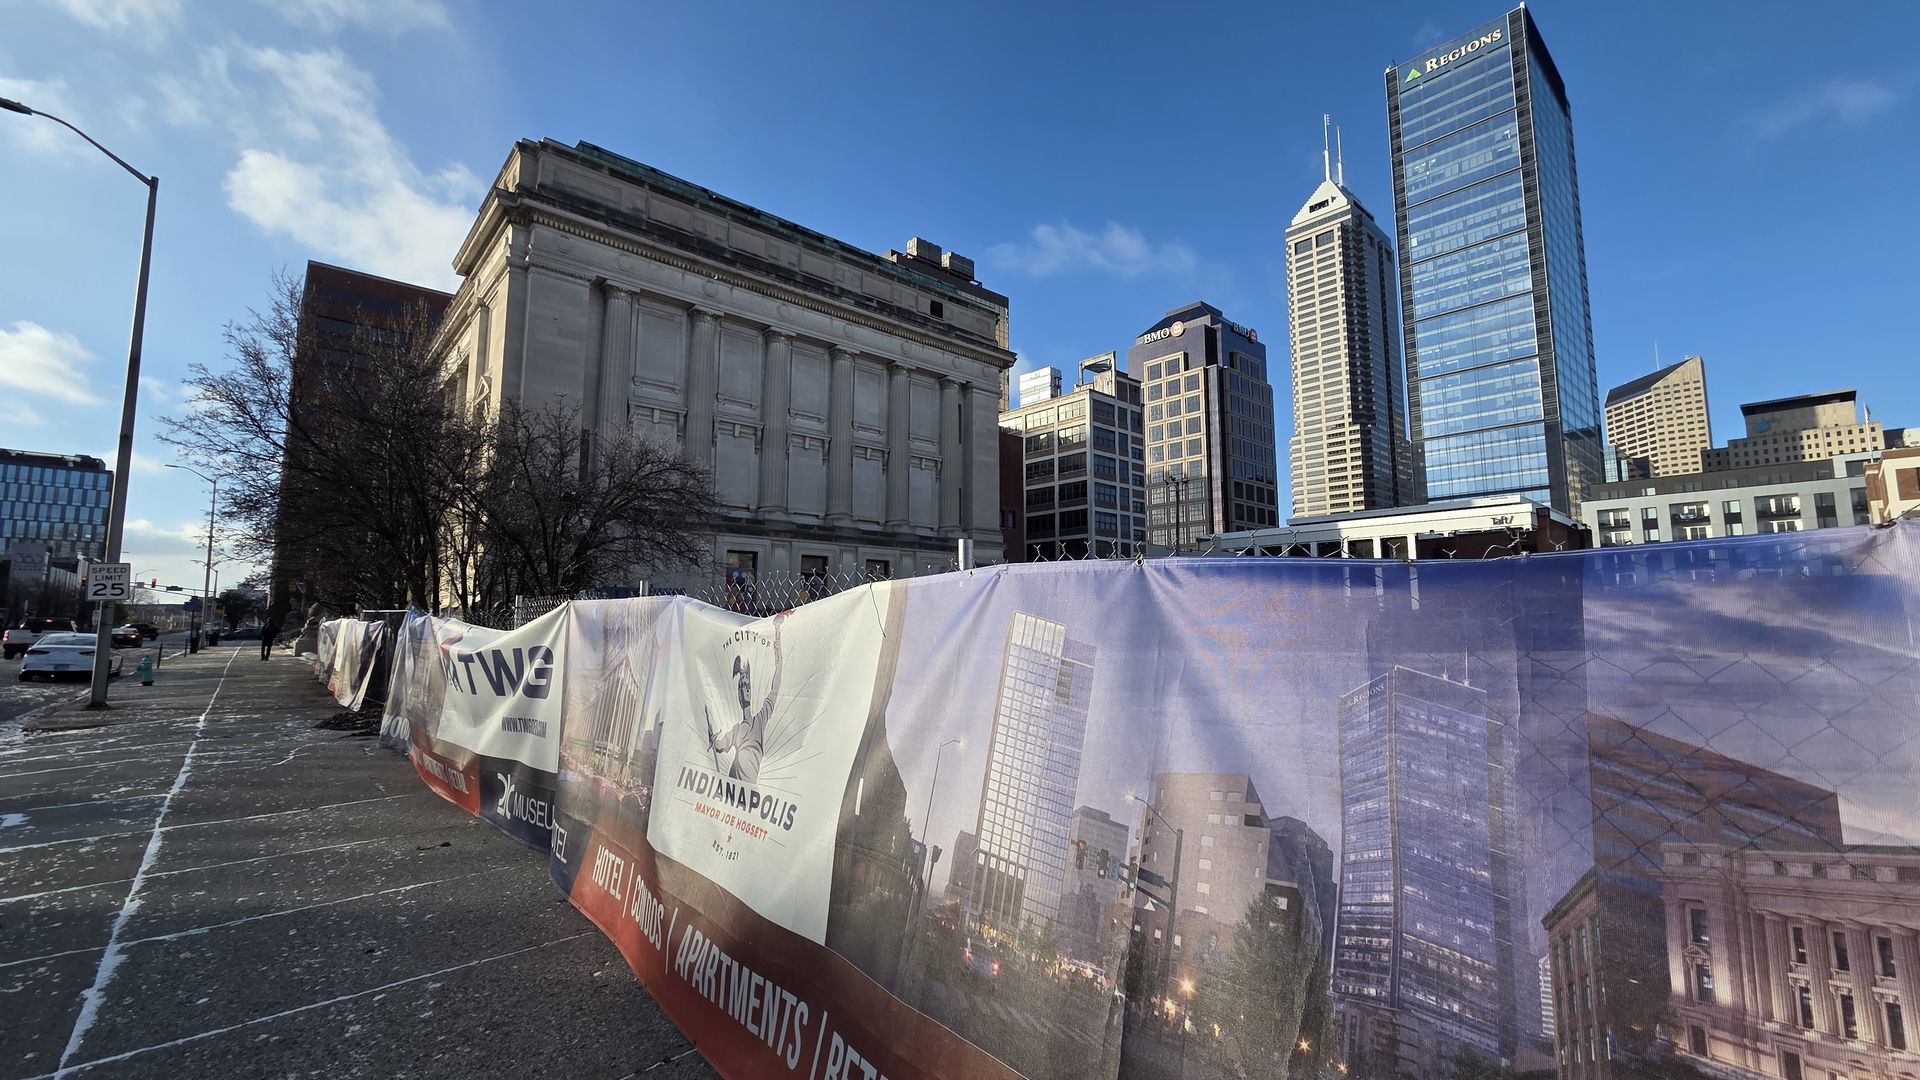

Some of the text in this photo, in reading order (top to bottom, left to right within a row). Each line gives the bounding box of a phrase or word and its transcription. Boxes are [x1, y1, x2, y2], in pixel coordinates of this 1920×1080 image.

[1425, 29, 1502, 73] REGIONS
[1143, 327, 1170, 344] BMO
[91, 566, 128, 574] SPEED
[92, 583, 125, 597] 25
[722, 630, 771, 650] THE CITY OF
[513, 791, 555, 830] MUSEU
[677, 766, 798, 831] INDIANAPOLIS
[695, 801, 768, 841] MAYOR JOE HOGSETT
[712, 840, 740, 861] EST. 1821
[592, 844, 625, 901] HOTEL
[630, 873, 665, 951] CONDOS
[674, 923, 809, 1071] APARTMENTS
